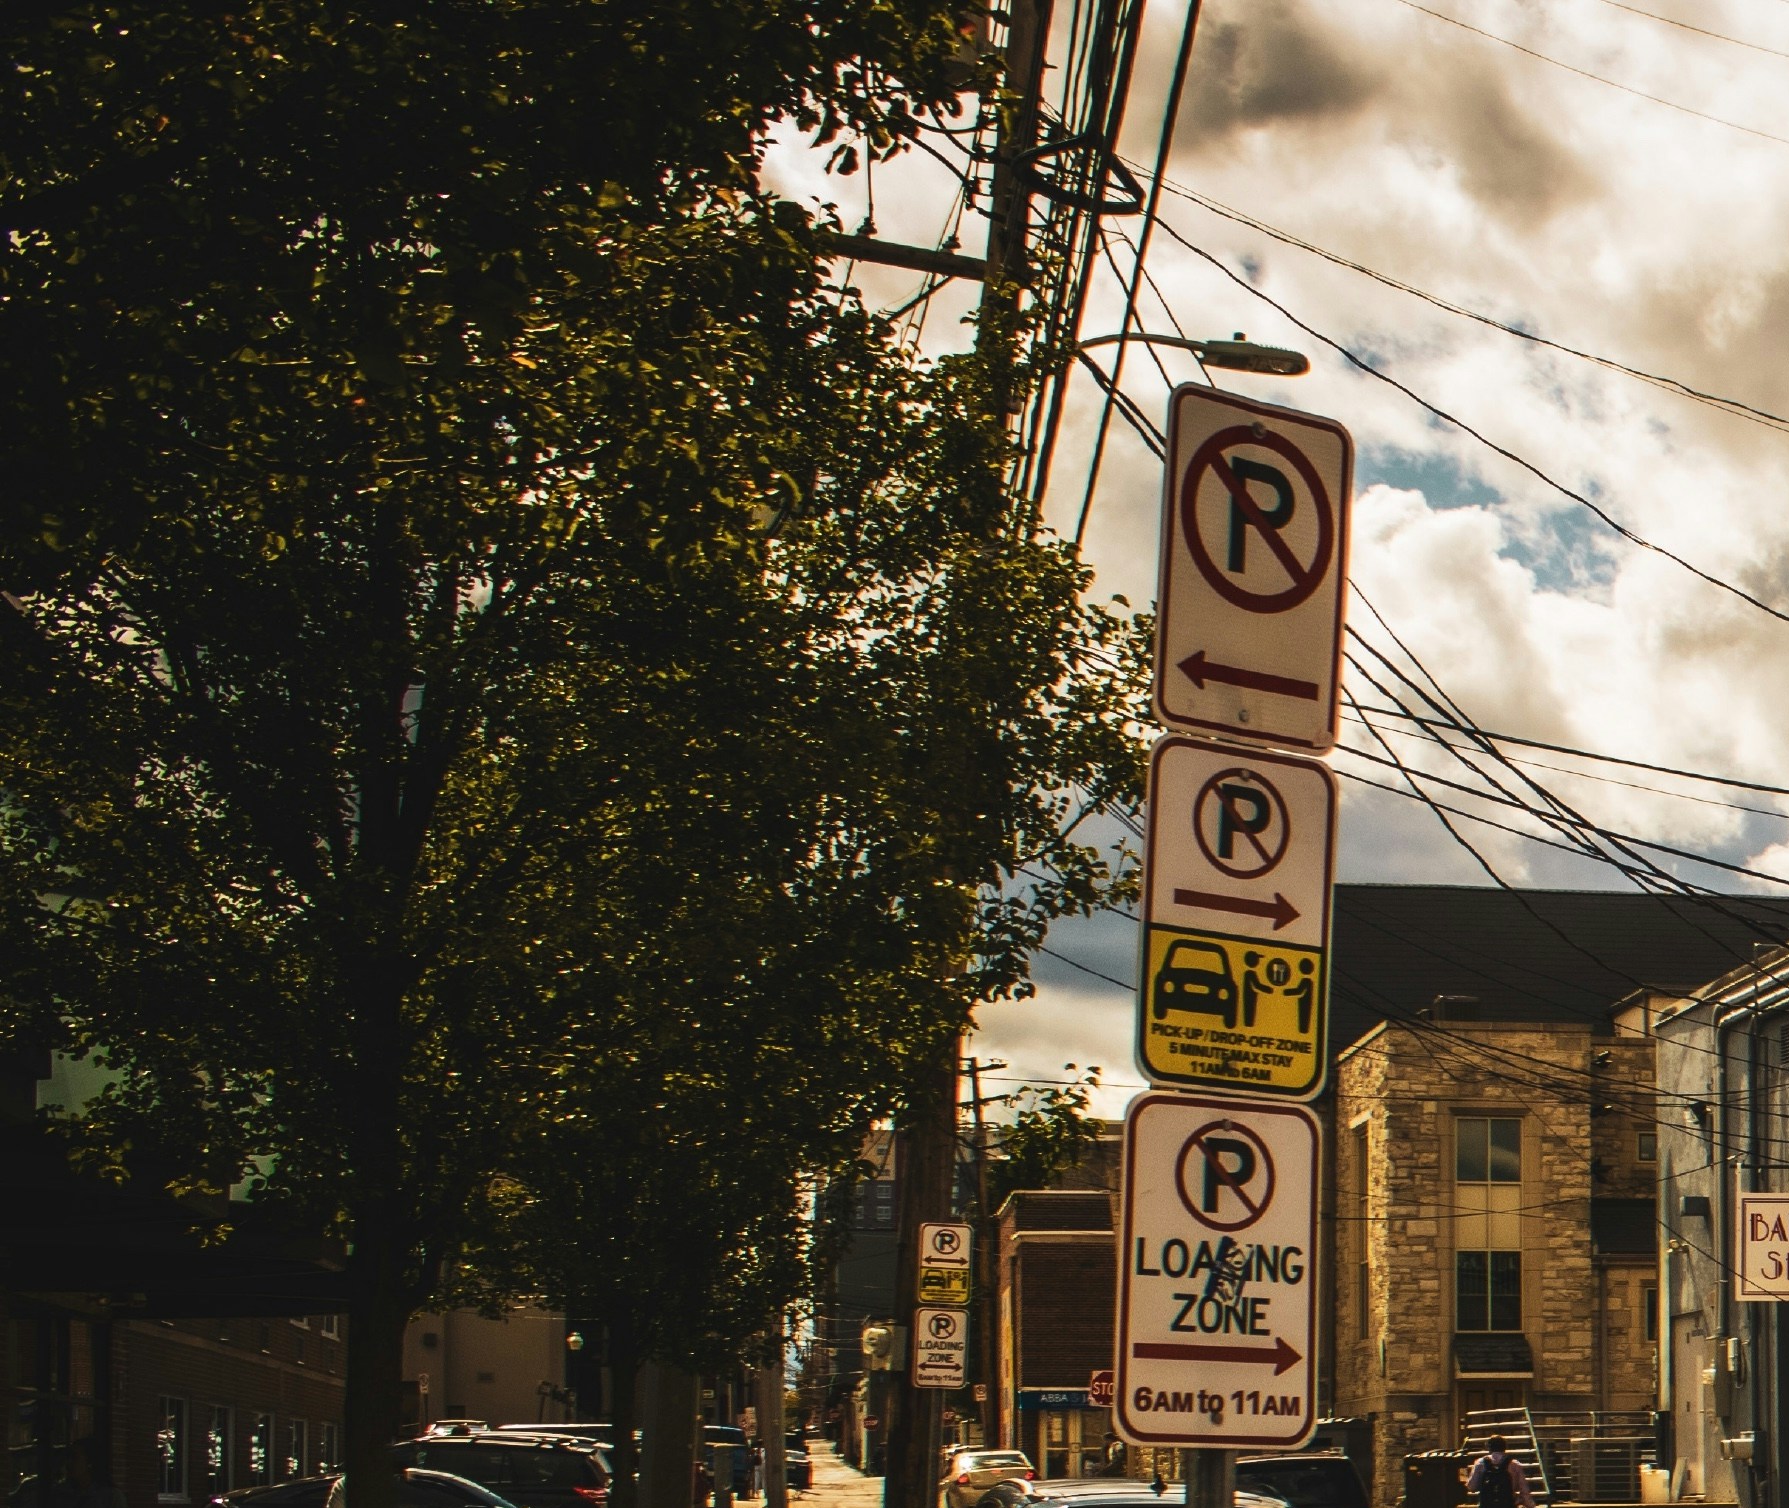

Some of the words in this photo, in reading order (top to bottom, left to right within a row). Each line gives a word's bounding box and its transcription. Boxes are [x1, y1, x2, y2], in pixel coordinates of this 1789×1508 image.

[1228, 455, 1296, 574] P
[1218, 782, 1272, 860] P
[1151, 1022, 1203, 1040] PICK-UP
[1211, 1030, 1276, 1048] DROP-OFF
[1275, 1040, 1312, 1054] ZONE
[1169, 1042, 1179, 1054] 5
[1180, 1043, 1229, 1060] MINUTE
[1230, 1050, 1262, 1065] MAX
[1262, 1053, 1294, 1068] STAY
[1241, 1067, 1272, 1081] 6AM
[1202, 1137, 1257, 1213] P
[1135, 1237, 1304, 1285] LOAING
[1170, 1292, 1271, 1336] ZONE
[918, 1340, 964, 1351] LOADING
[927, 1353, 955, 1363] ZONE
[1040, 1393, 1068, 1402] ABBA
[1092, 1382, 1114, 1395] STO
[1133, 1386, 1193, 1413] 6AM
[1198, 1389, 1224, 1414] to
[1231, 1390, 1300, 1416] 11AM
